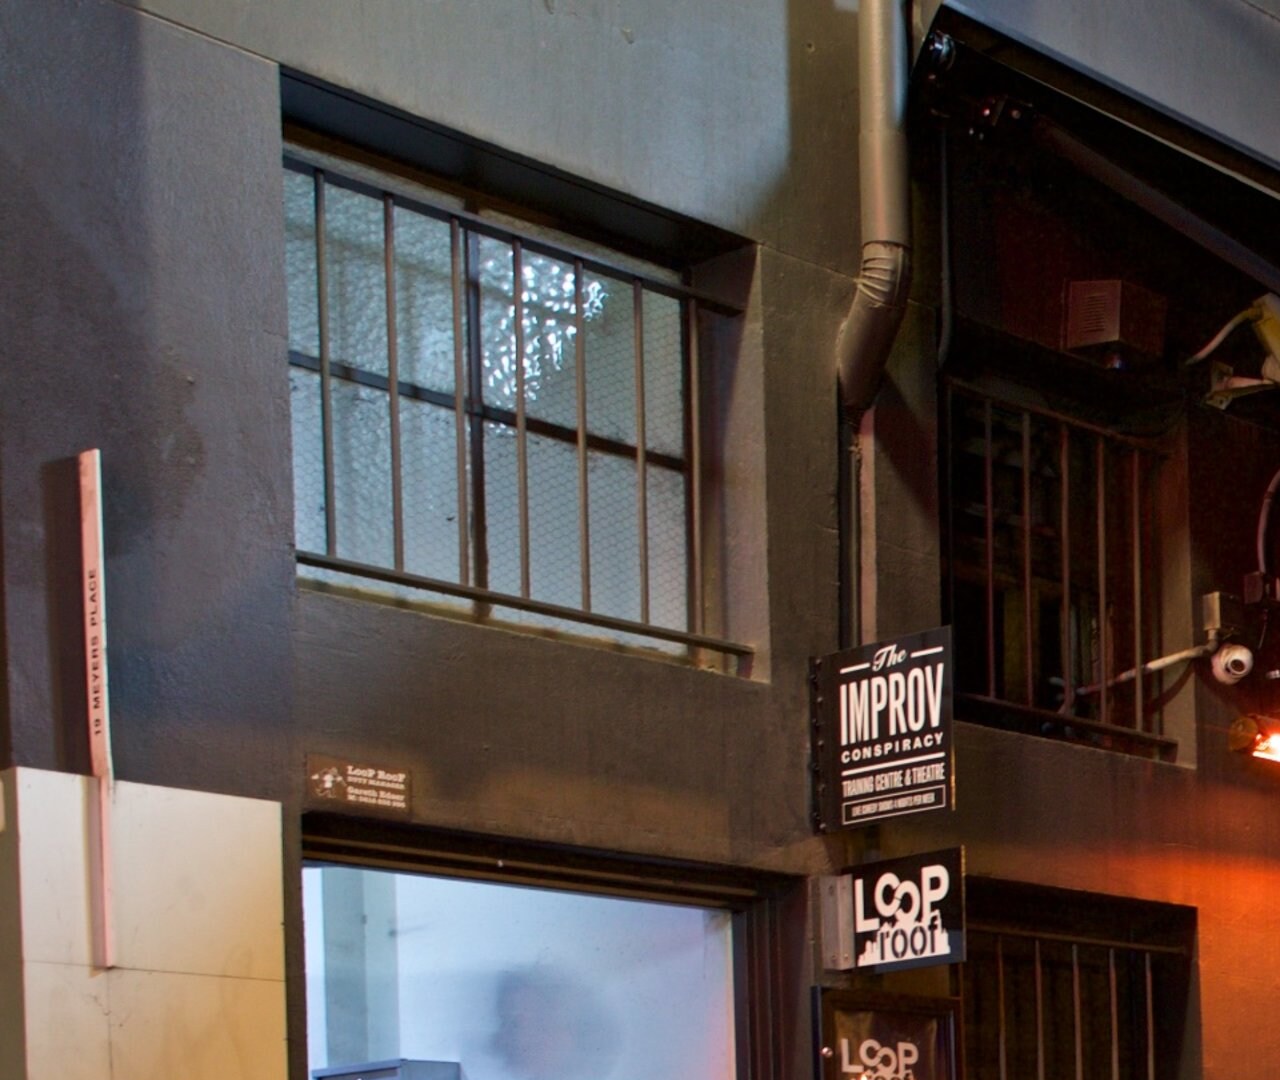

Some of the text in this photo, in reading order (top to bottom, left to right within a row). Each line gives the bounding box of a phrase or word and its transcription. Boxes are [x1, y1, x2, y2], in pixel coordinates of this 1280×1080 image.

[88, 569, 98, 627] PLACE
[91, 636, 101, 710] MEYERS
[872, 644, 907, 672] The
[840, 663, 944, 747] IMPROV
[841, 732, 944, 764] CONSPIRACY
[842, 775, 874, 798] TRAINING
[875, 769, 903, 792] CENTRE
[912, 762, 945, 785] THEATRE
[854, 864, 950, 933] LOOP
[880, 914, 939, 961] roof
[841, 1038, 919, 1074] LOOP
